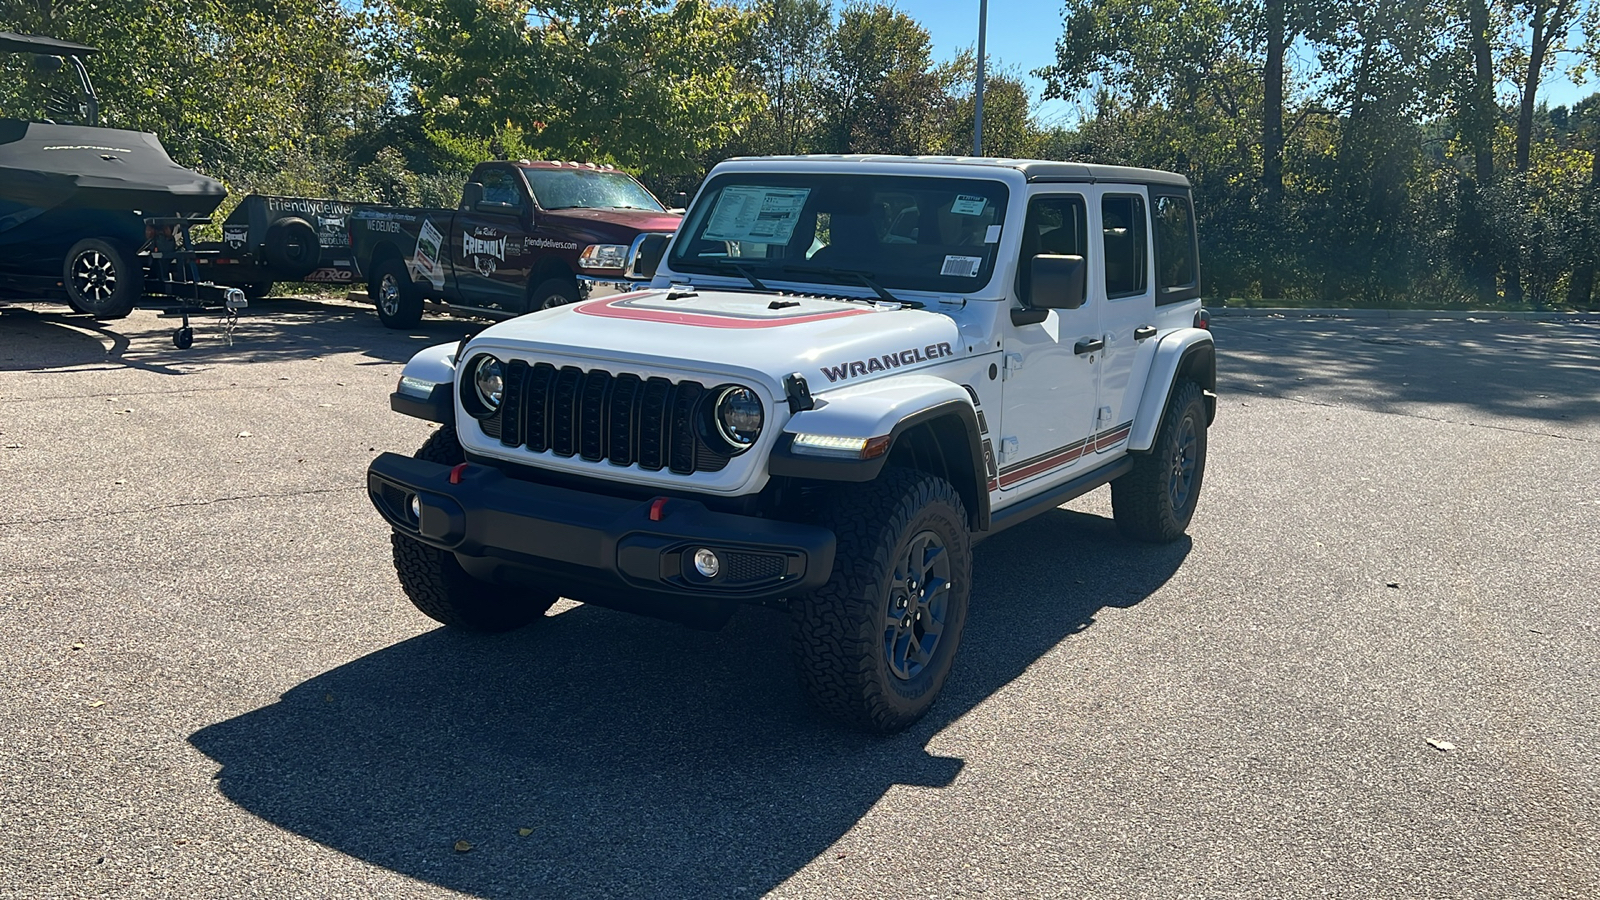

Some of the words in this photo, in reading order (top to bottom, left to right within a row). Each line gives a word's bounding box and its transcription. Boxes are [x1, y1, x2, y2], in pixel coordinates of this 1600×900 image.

[366, 220, 376, 231] WE
[463, 230, 508, 262] FRIENDLY
[524, 236, 578, 250] Friendlydelivers.com
[820, 341, 954, 383] WRANGLER
